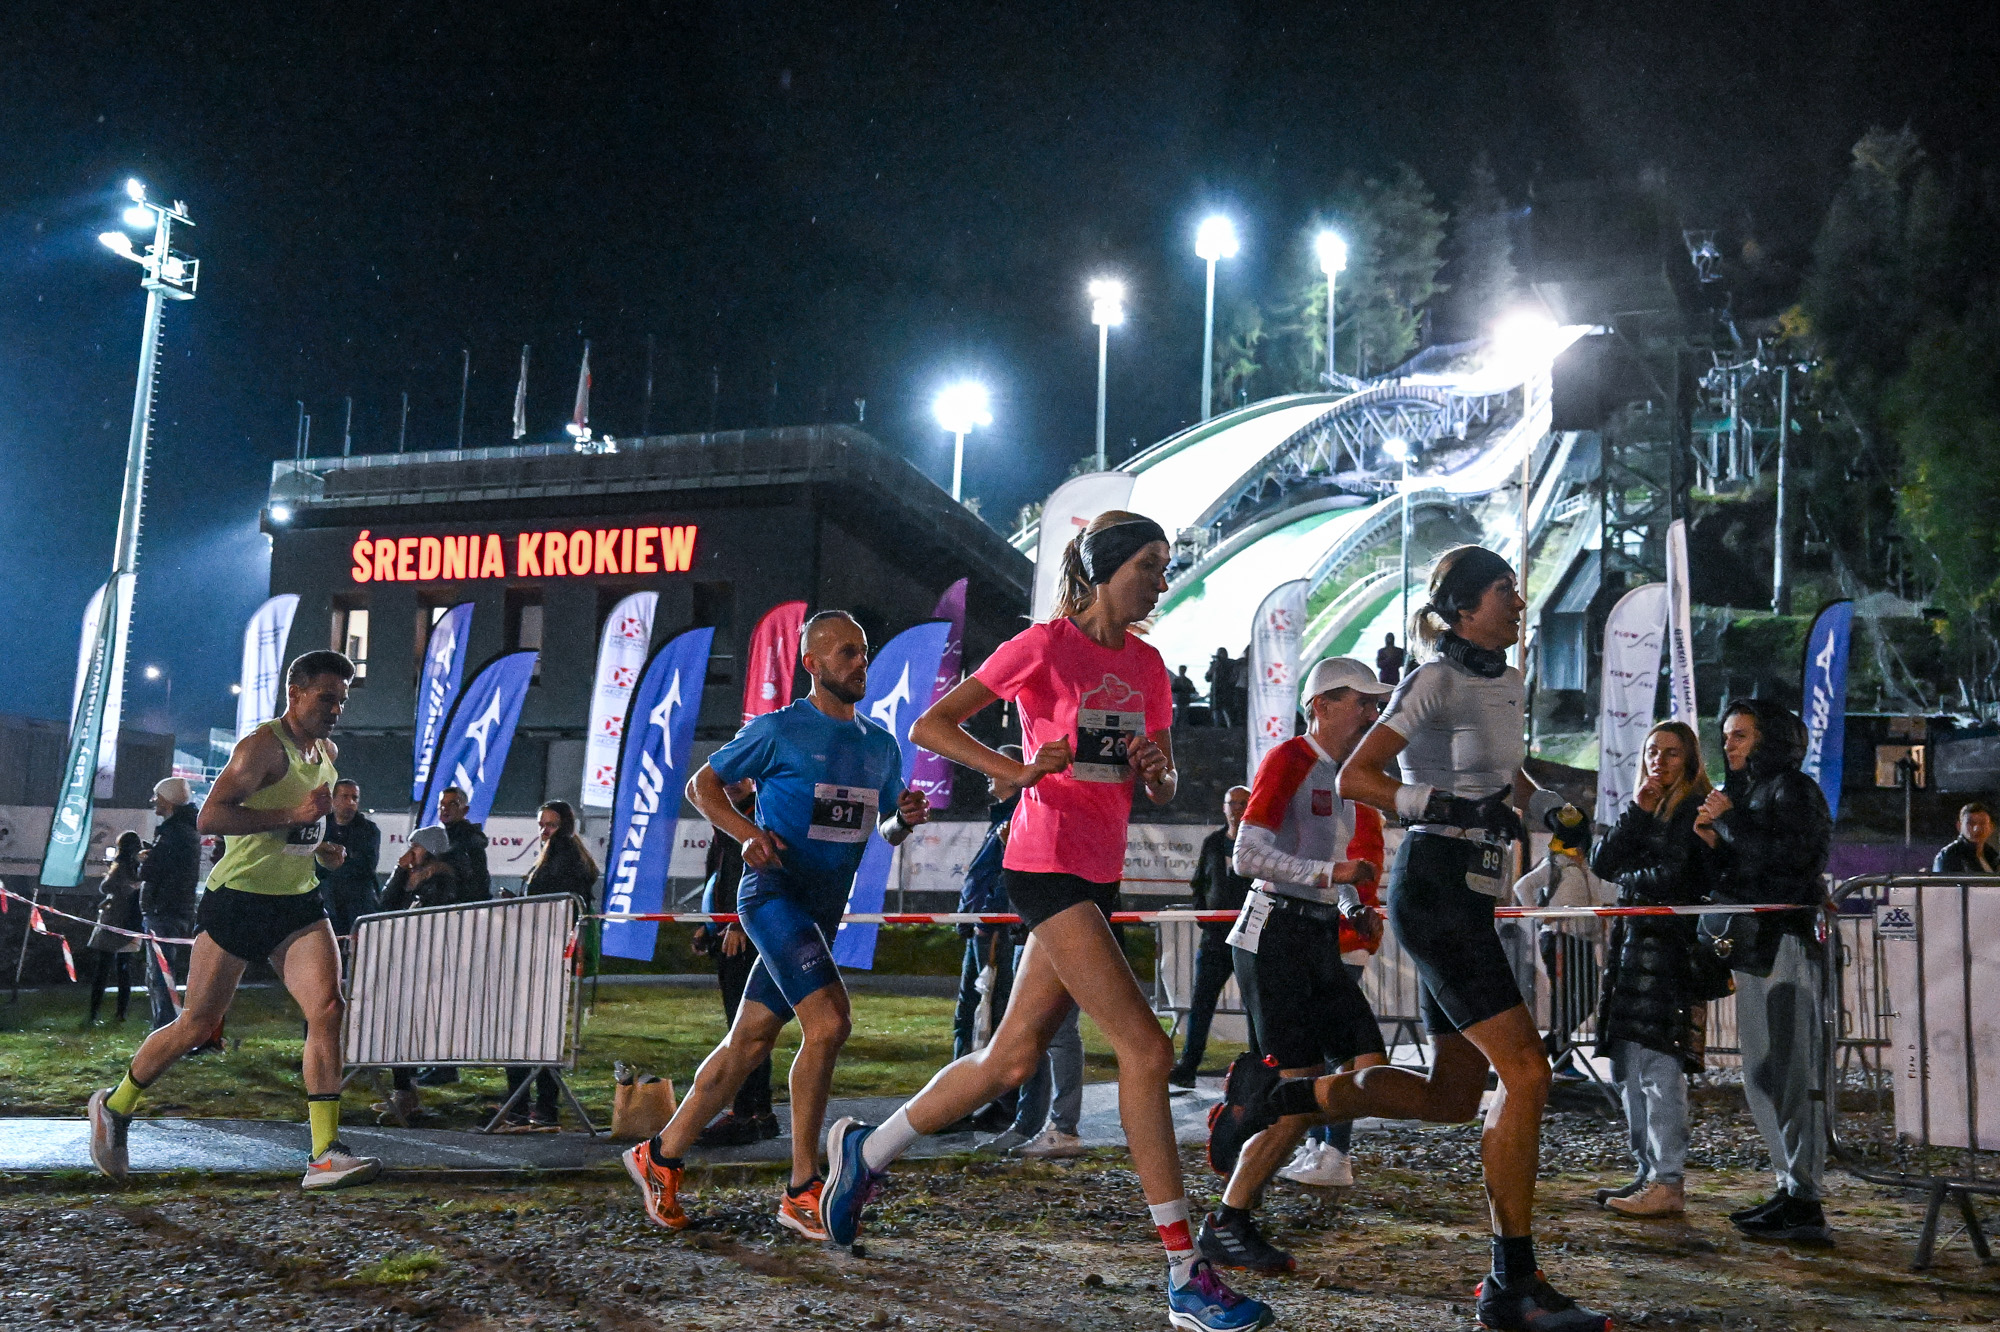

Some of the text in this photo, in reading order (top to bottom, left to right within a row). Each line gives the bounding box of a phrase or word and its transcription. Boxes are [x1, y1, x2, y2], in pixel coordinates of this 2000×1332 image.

[351, 525, 698, 583] ŚREDNIA KROKIEW
[1100, 736, 1127, 757] 26
[69, 746, 91, 788] Lasy
[830, 805, 854, 823] 91
[300, 827, 320, 840] 154
[491, 837, 523, 846] LOW
[683, 839, 709, 848] FLO
[1482, 850, 1500, 871] 89
